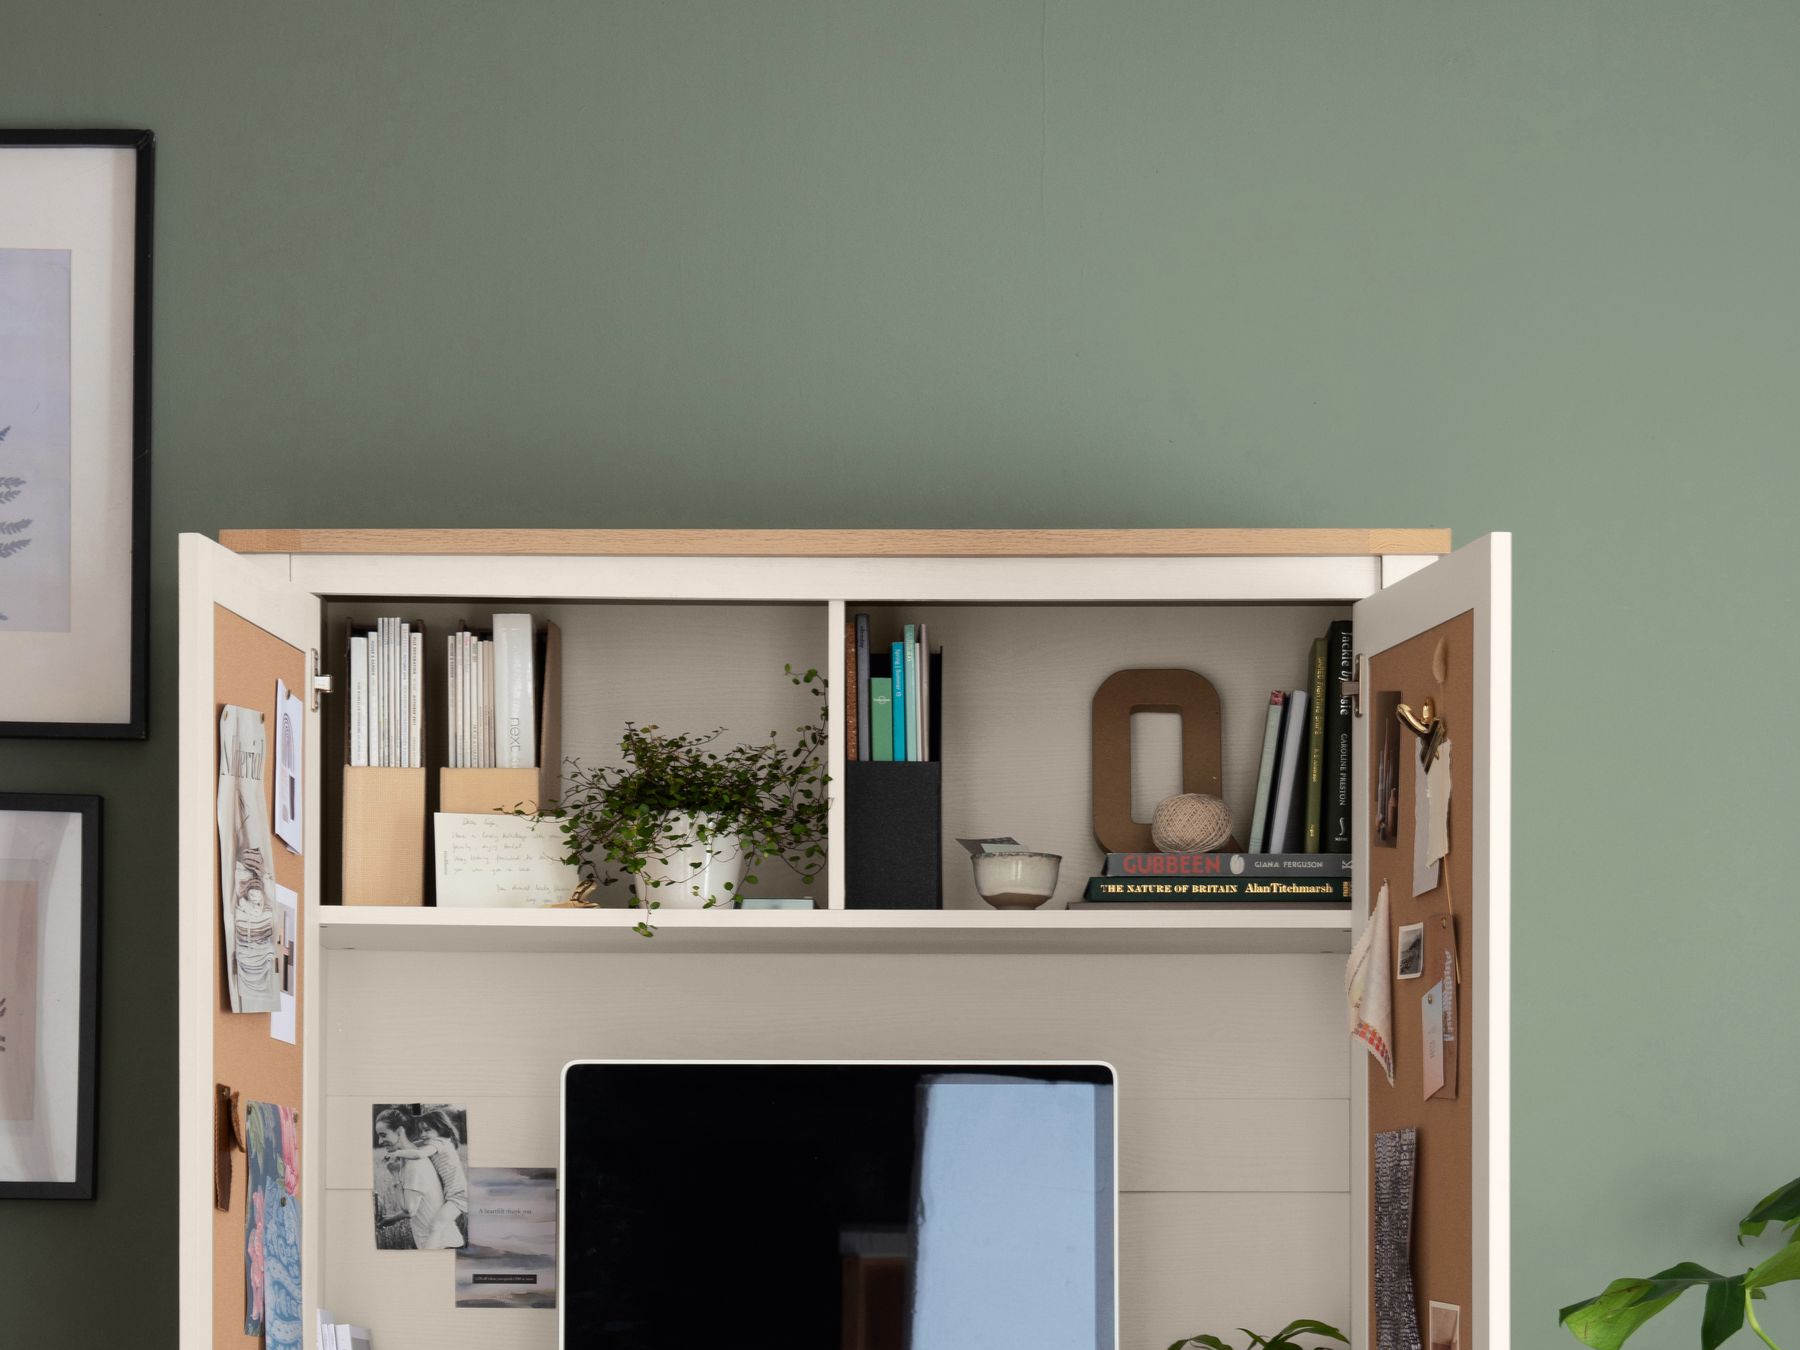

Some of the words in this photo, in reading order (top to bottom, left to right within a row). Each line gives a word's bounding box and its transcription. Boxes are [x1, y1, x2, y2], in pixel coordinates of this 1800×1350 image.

[1340, 631, 1352, 667] Jackie
[509, 717, 521, 752] next
[1339, 733, 1348, 771] CAROLINE
[1339, 772, 1347, 806] PRESTON
[1122, 854, 1221, 875] GUBBEEN
[1100, 884, 1125, 893] THE
[1126, 884, 1172, 893] NATURE
[1174, 884, 1188, 893] OF
[1192, 884, 1238, 893] BRITAIN
